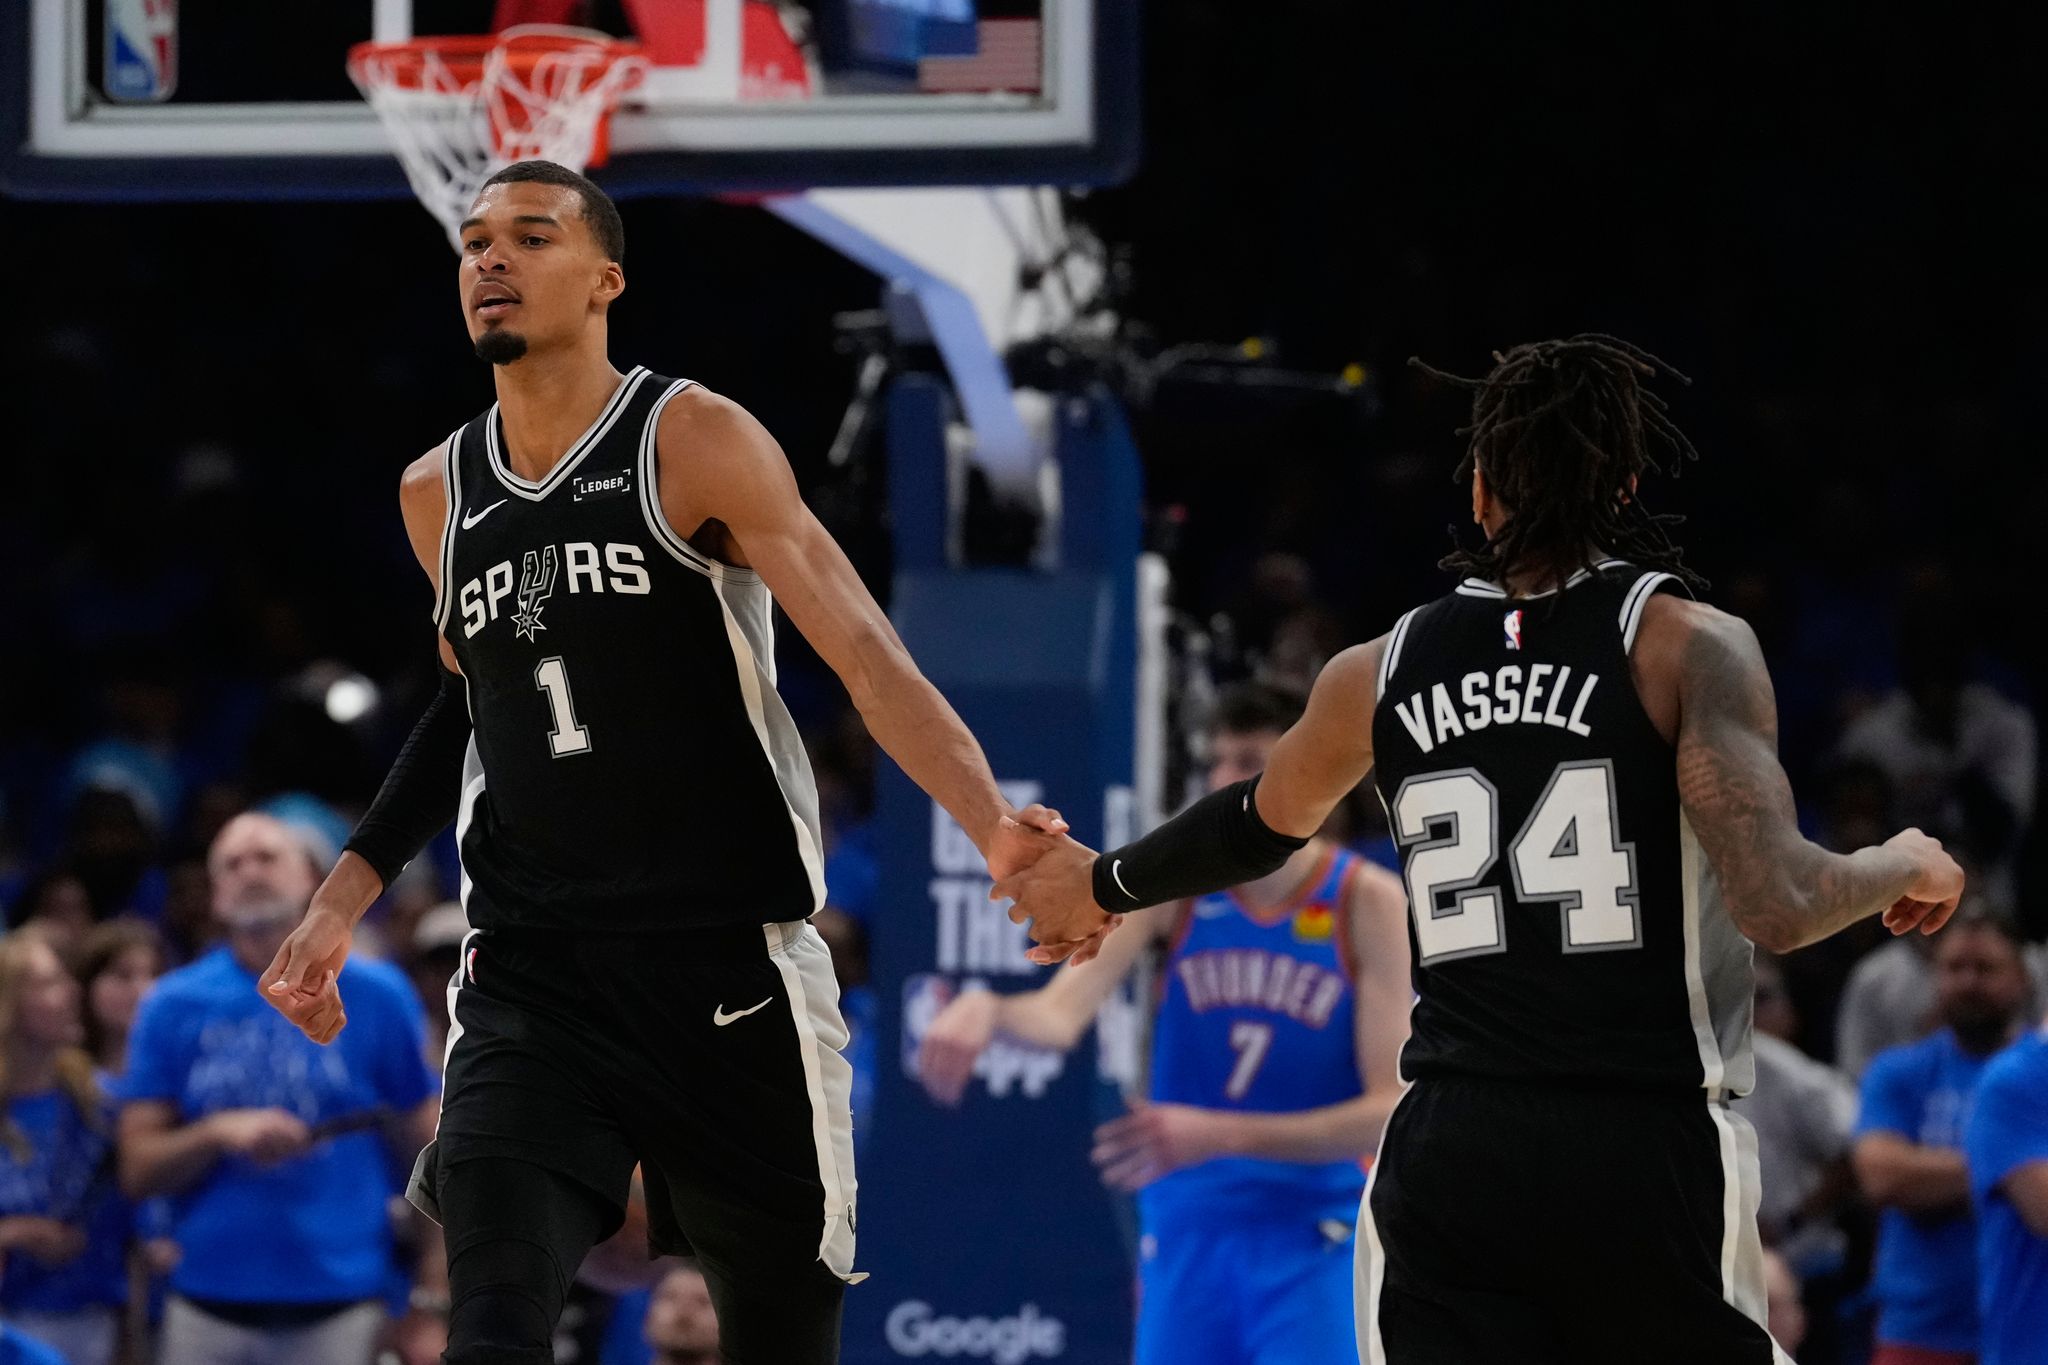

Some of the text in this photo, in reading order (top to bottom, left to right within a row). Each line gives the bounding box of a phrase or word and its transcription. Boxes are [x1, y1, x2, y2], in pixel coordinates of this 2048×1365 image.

[581, 477, 624, 493] LEDGER
[534, 656, 592, 759] 1
[1395, 664, 1600, 753] VASSELL
[1392, 758, 1643, 967] 24
[1178, 949, 1344, 1030] THUNDER
[1226, 1019, 1274, 1101] 7
[885, 1300, 1066, 1365] Google
